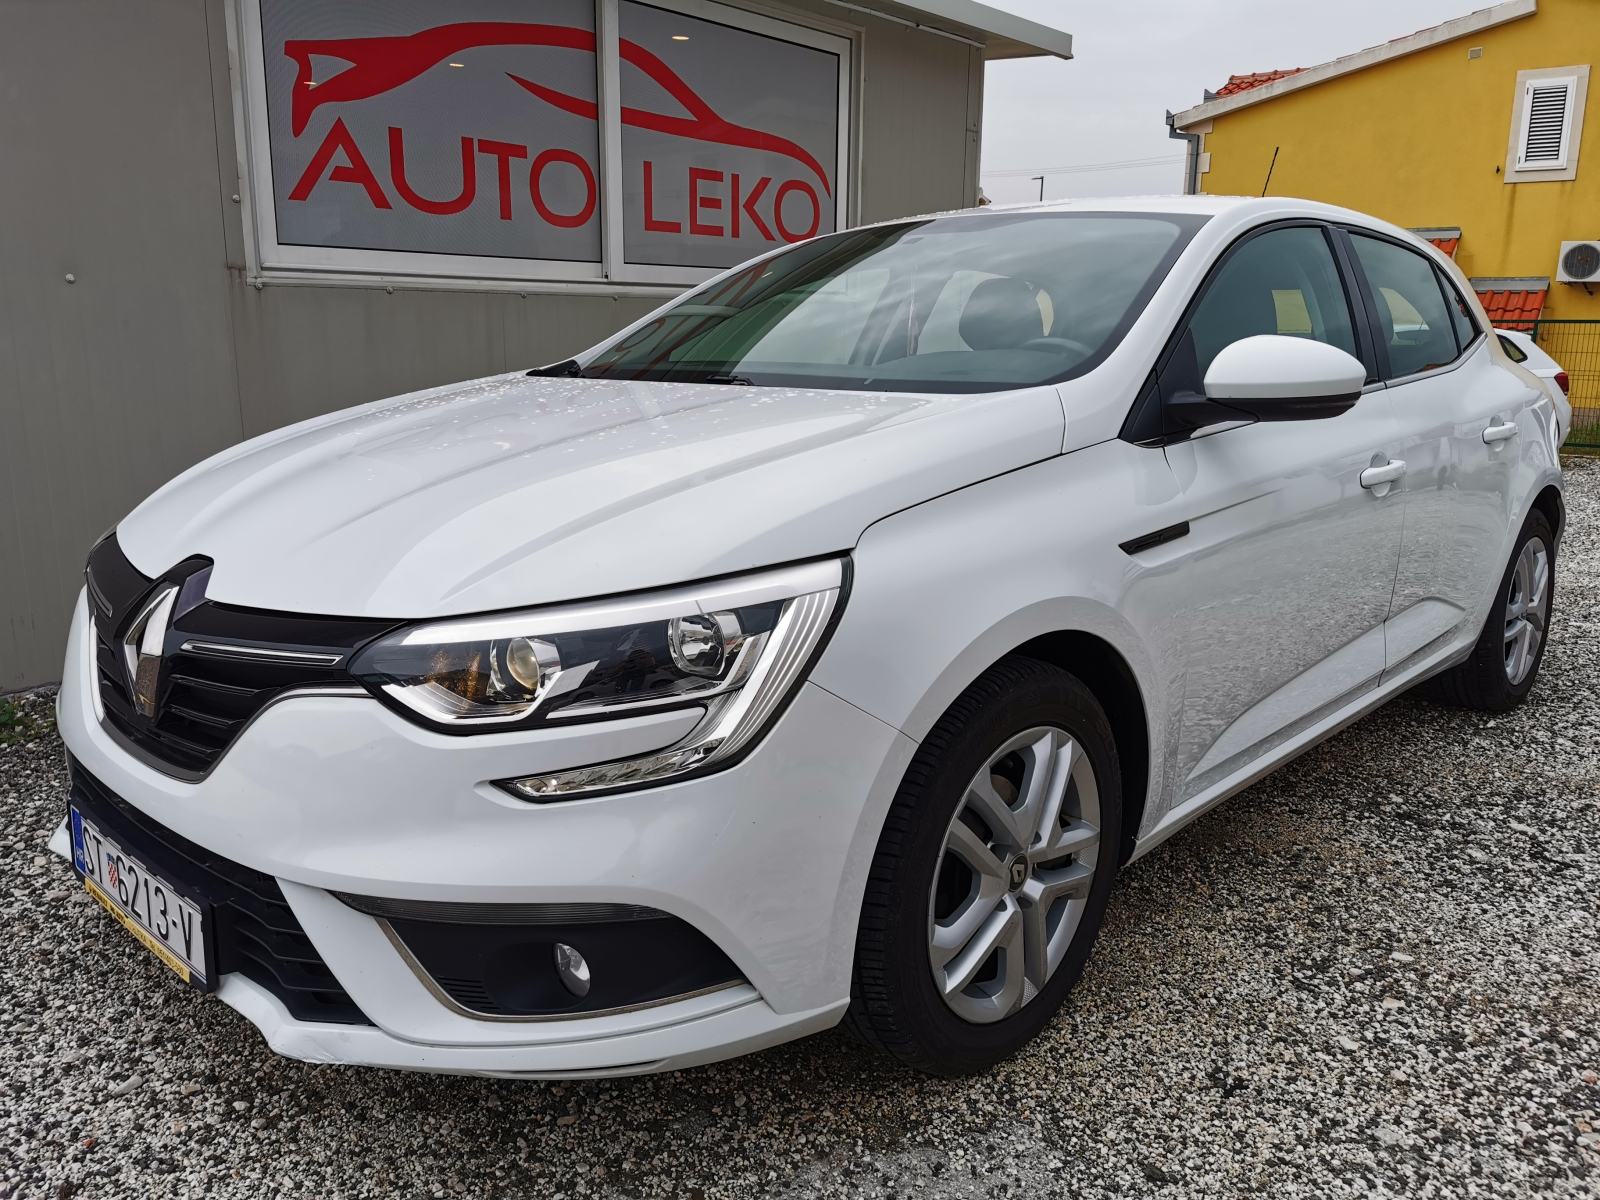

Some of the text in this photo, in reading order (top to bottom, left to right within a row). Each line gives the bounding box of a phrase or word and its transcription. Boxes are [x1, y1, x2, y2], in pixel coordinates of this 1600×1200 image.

[288, 116, 820, 244] AUTO LEKO
[83, 825, 103, 884] ST
[116, 854, 192, 961] 6213-V
